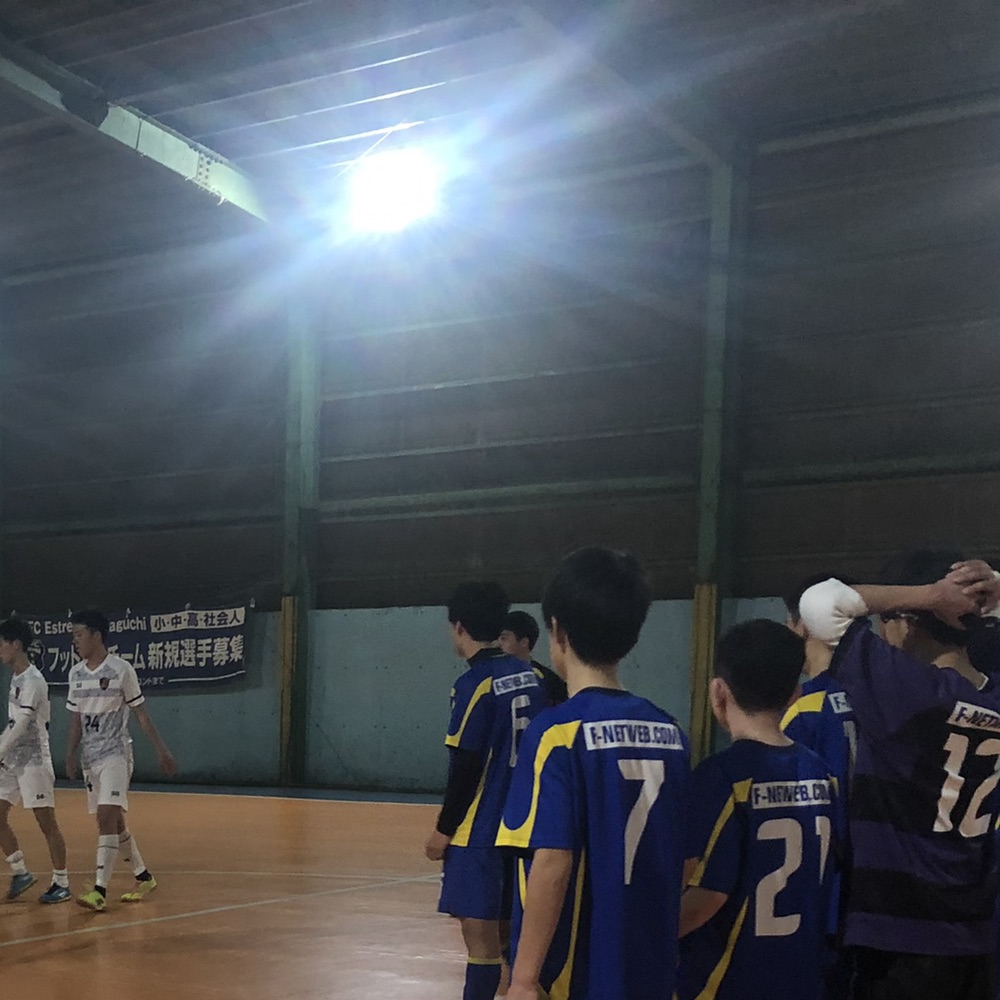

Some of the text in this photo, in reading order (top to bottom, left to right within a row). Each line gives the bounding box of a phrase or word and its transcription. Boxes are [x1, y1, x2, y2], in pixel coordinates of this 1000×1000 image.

[109, 616, 147, 633] aguchi
[618, 759, 665, 886] 7
[933, 732, 1000, 838] 12
